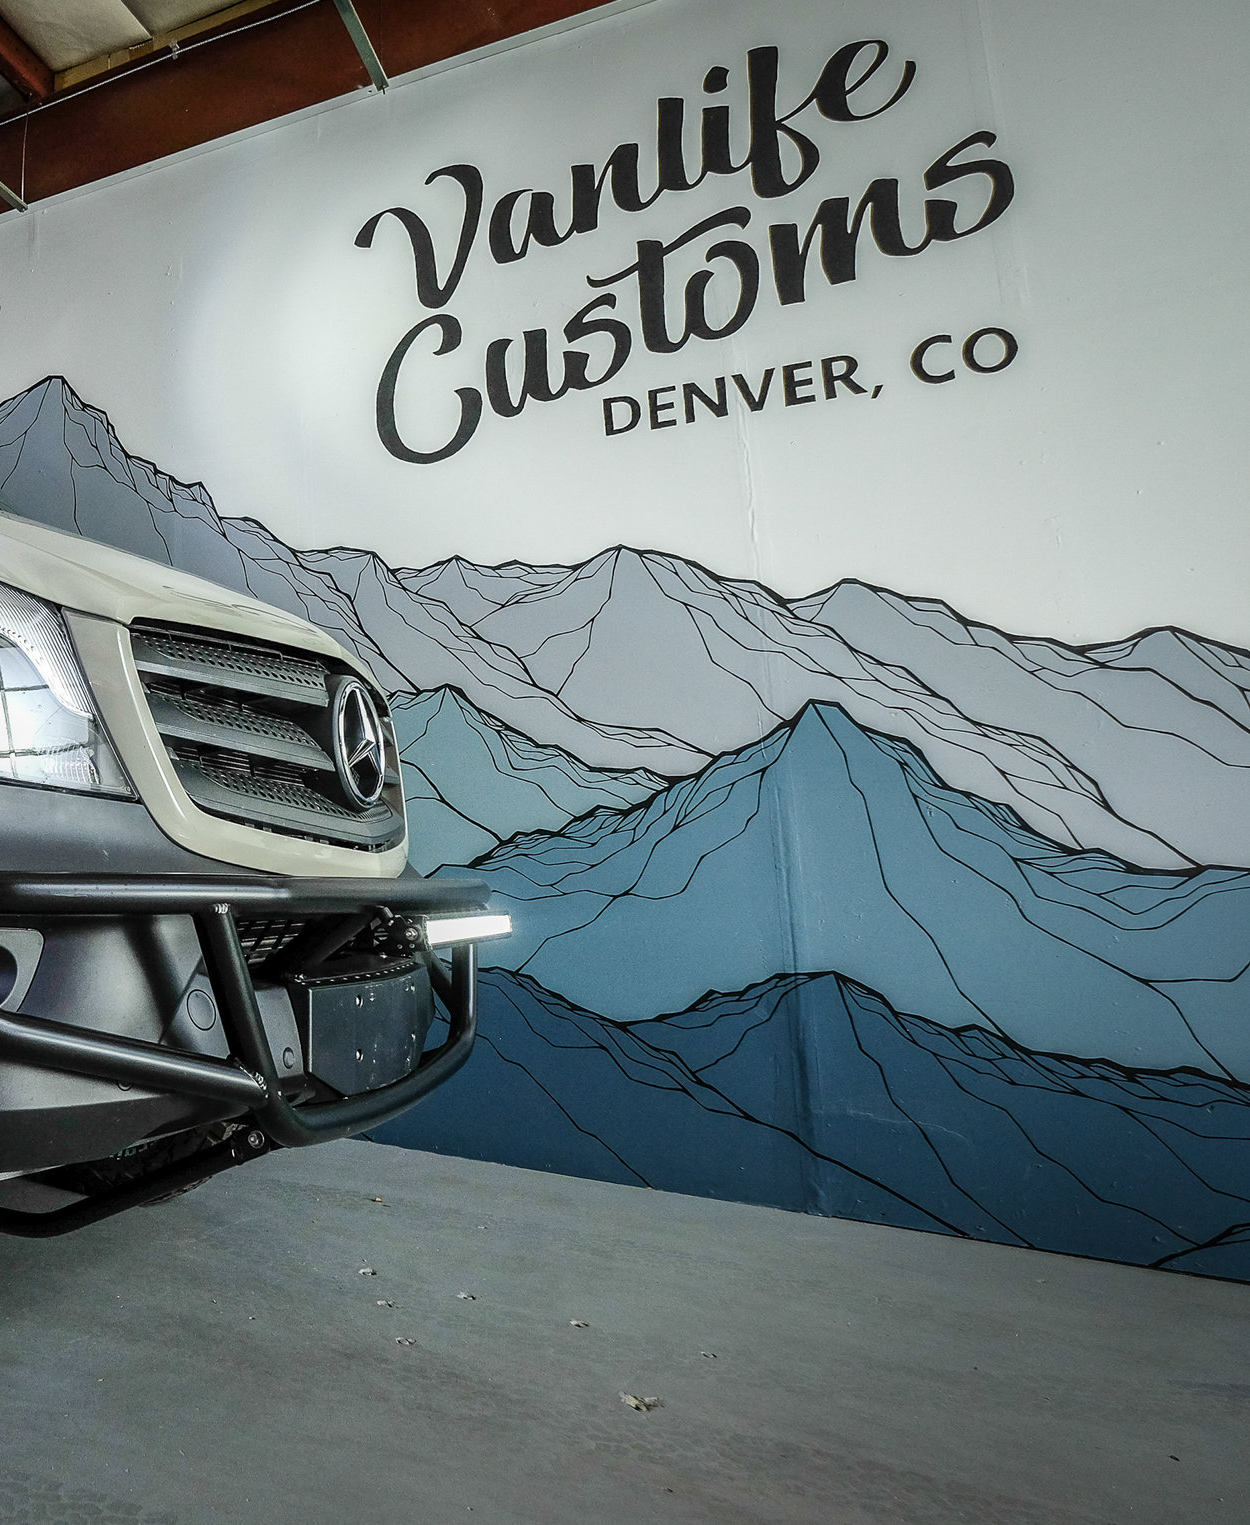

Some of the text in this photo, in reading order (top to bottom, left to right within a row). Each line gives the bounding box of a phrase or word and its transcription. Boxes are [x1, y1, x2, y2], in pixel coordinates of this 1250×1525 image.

[354, 39, 917, 309] Vanlife
[375, 130, 1015, 465] Customs
[602, 327, 1019, 437] DENVER, CO
